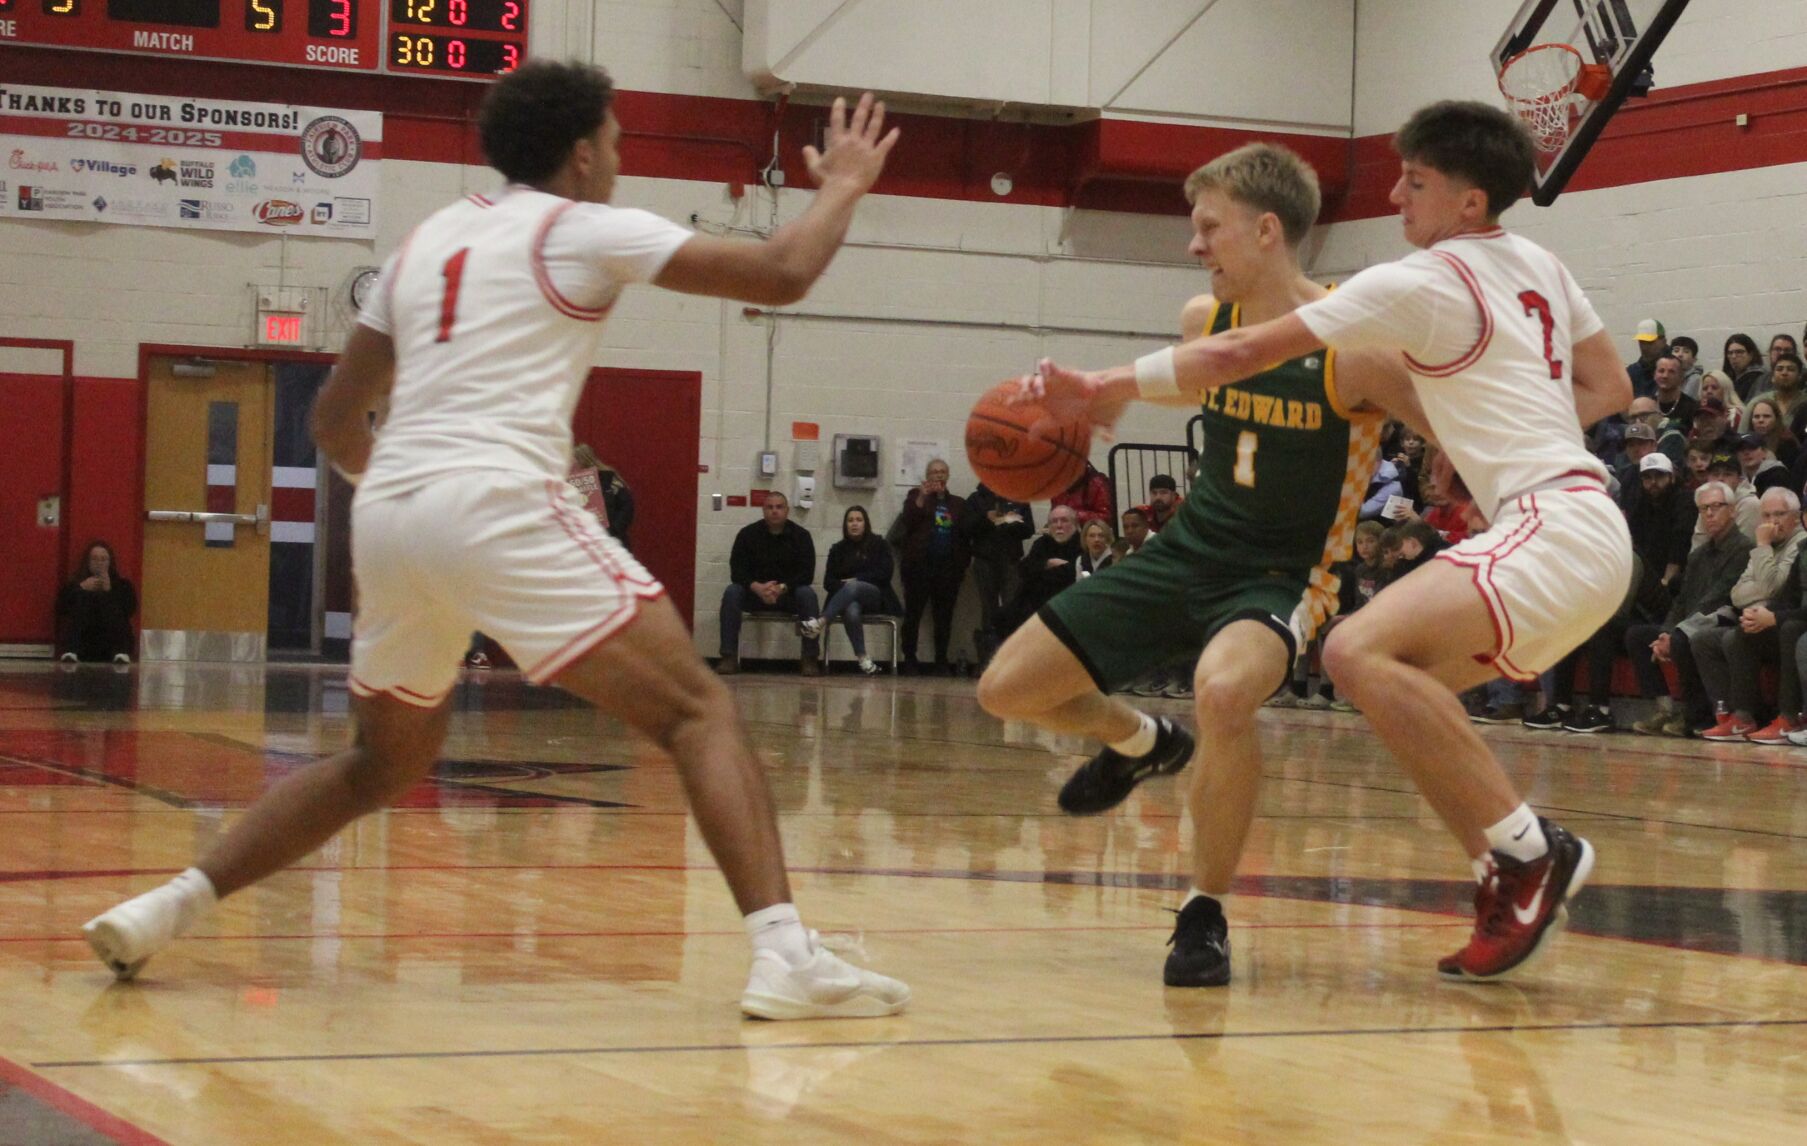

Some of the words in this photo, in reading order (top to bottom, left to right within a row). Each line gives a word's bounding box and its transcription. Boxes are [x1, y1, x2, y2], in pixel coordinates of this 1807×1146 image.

[501, 1, 520, 30] 2
[134, 30, 193, 51] MATCH
[306, 44, 359, 65] SCORE
[398, 36, 433, 66] 30
[447, 40, 466, 68] 0
[503, 44, 518, 73] 3
[96, 99, 121, 117] TO
[131, 103, 171, 121] OUR
[181, 103, 298, 130] SPONSORS!
[67, 122, 222, 147] 2024-2025
[87, 160, 137, 177] Village
[180, 168, 214, 179] WILD
[180, 179, 214, 188] WINGS
[226, 181, 258, 193] ellie
[434, 247, 471, 343] 1
[266, 316, 301, 342] EXIT
[1517, 289, 1562, 380] 2
[1223, 387, 1322, 431] EDWARD
[1233, 430, 1258, 488] 1
